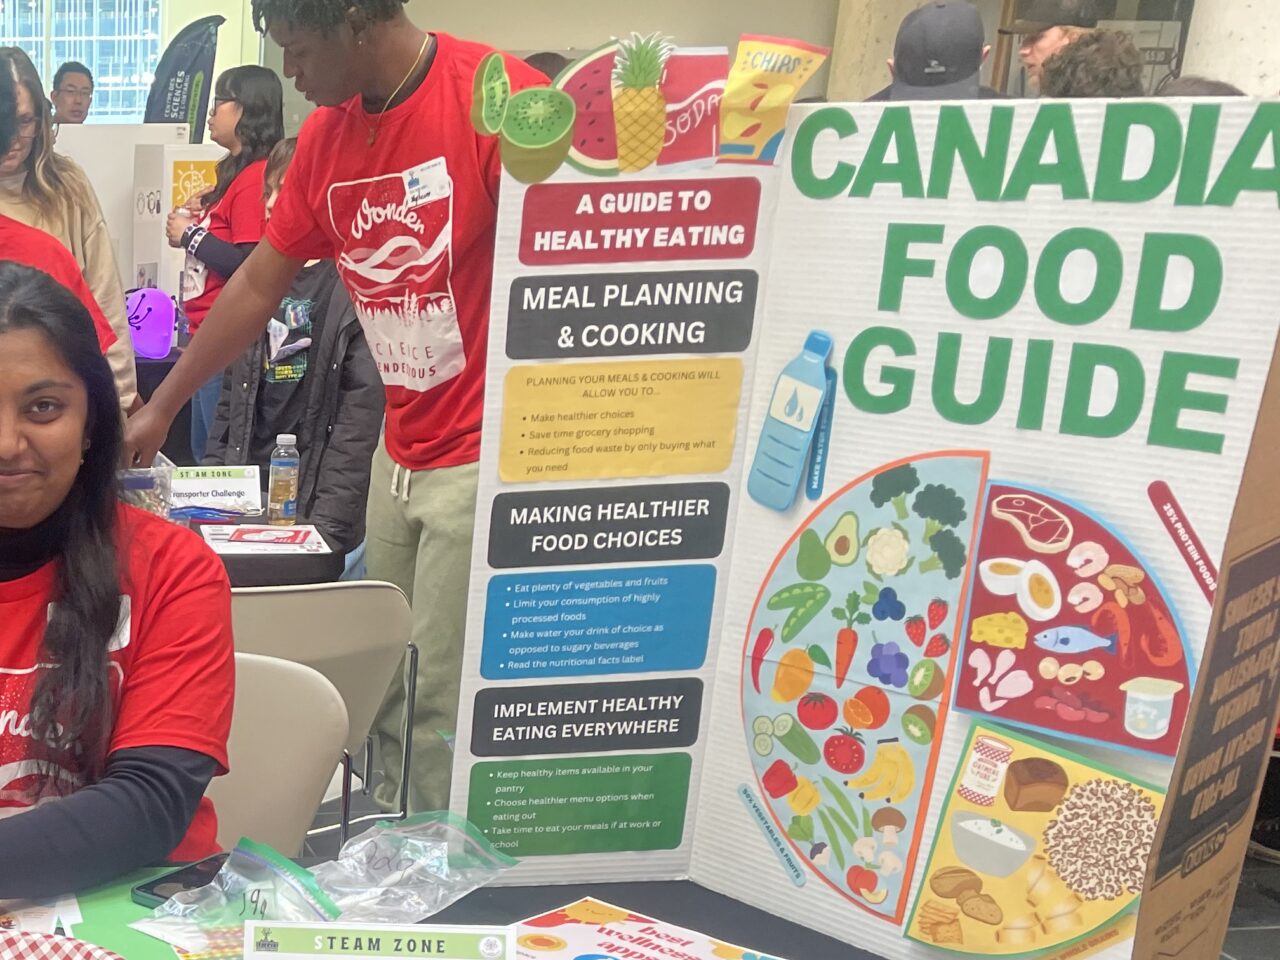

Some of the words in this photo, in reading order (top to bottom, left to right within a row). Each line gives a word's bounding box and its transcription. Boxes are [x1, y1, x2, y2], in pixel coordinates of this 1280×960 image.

[751, 51, 801, 73] CHIPS
[170, 70, 185, 118] SCIENCES
[663, 92, 726, 147] SODA
[576, 195, 594, 215] A
[600, 191, 673, 213] GUIDE
[678, 190, 712, 211] TO
[352, 198, 424, 239] Wonder
[534, 228, 653, 251] HEALTHY
[653, 225, 745, 247] EATING
[876, 222, 1224, 332] FOOD
[522, 286, 596, 310] MEAL
[603, 281, 743, 307] PLANNING
[557, 326, 574, 348] &
[581, 321, 705, 347] COOKING
[526, 377, 576, 387] PLANNING
[578, 375, 605, 384] YOUR
[607, 374, 640, 383] MEALS
[641, 373, 648, 382] &
[650, 371, 696, 382] COOKING
[698, 370, 720, 380] WILL
[582, 388, 616, 398] ALLOW
[618, 387, 638, 397] YOU
[843, 326, 1241, 455] GUIDE
[531, 413, 554, 423] Make
[557, 411, 597, 421] healthier
[600, 409, 635, 419] choices
[529, 430, 551, 440] Save
[553, 429, 574, 438] time
[576, 429, 612, 440] grocery
[614, 425, 655, 437] shopping
[528, 445, 570, 458] Reducing
[573, 443, 593, 454] food
[596, 444, 623, 453] waste
[625, 442, 636, 454] by
[638, 441, 657, 453] only
[659, 439, 691, 452] buying
[693, 439, 715, 449] what
[526, 465, 545, 475] you
[547, 463, 568, 472] need
[211, 490, 245, 498] Challenge
[510, 503, 592, 525] MAKING
[597, 499, 710, 521] HEALTHIER
[531, 533, 588, 552] FOOD
[593, 528, 683, 549] CHOICES
[1162, 502, 1180, 524] 25%
[1173, 521, 1201, 562] PROTEIN
[1195, 559, 1219, 592] FOODS
[514, 584, 528, 593] Eat
[531, 582, 558, 594] plenty
[561, 582, 572, 590] of
[574, 578, 622, 590] vegetables
[625, 577, 642, 587] and
[644, 576, 668, 585] fruits
[535, 599, 557, 609] your
[560, 594, 620, 608] consumption
[622, 594, 632, 603] of
[634, 592, 661, 604] highly
[512, 613, 558, 625] processed
[561, 612, 587, 622] foods
[510, 630, 533, 640] Make
[536, 629, 562, 638] water
[563, 629, 584, 639] your
[586, 625, 609, 635] drink
[611, 625, 621, 633] of
[623, 623, 651, 633] choice
[653, 624, 663, 632] as
[509, 644, 547, 656] opposed
[550, 643, 560, 652] to
[562, 642, 591, 653] sugary
[593, 640, 639, 651] beverages
[508, 660, 528, 670] Read
[531, 660, 547, 668] the
[549, 657, 595, 668] nutritional
[598, 656, 620, 665] facts
[622, 655, 644, 663] label
[493, 700, 598, 718] IMPLEMENT
[602, 695, 684, 712] HEALTHY
[492, 723, 557, 742] EATING
[561, 718, 680, 738] EVERYWHERE
[741, 788, 754, 804] 50%
[751, 803, 782, 848] VEGETABLES
[782, 853, 802, 880] FRUITS
[314, 935, 381, 951] STEAM
[394, 939, 446, 954] ZONE
[638, 926, 696, 948] best
